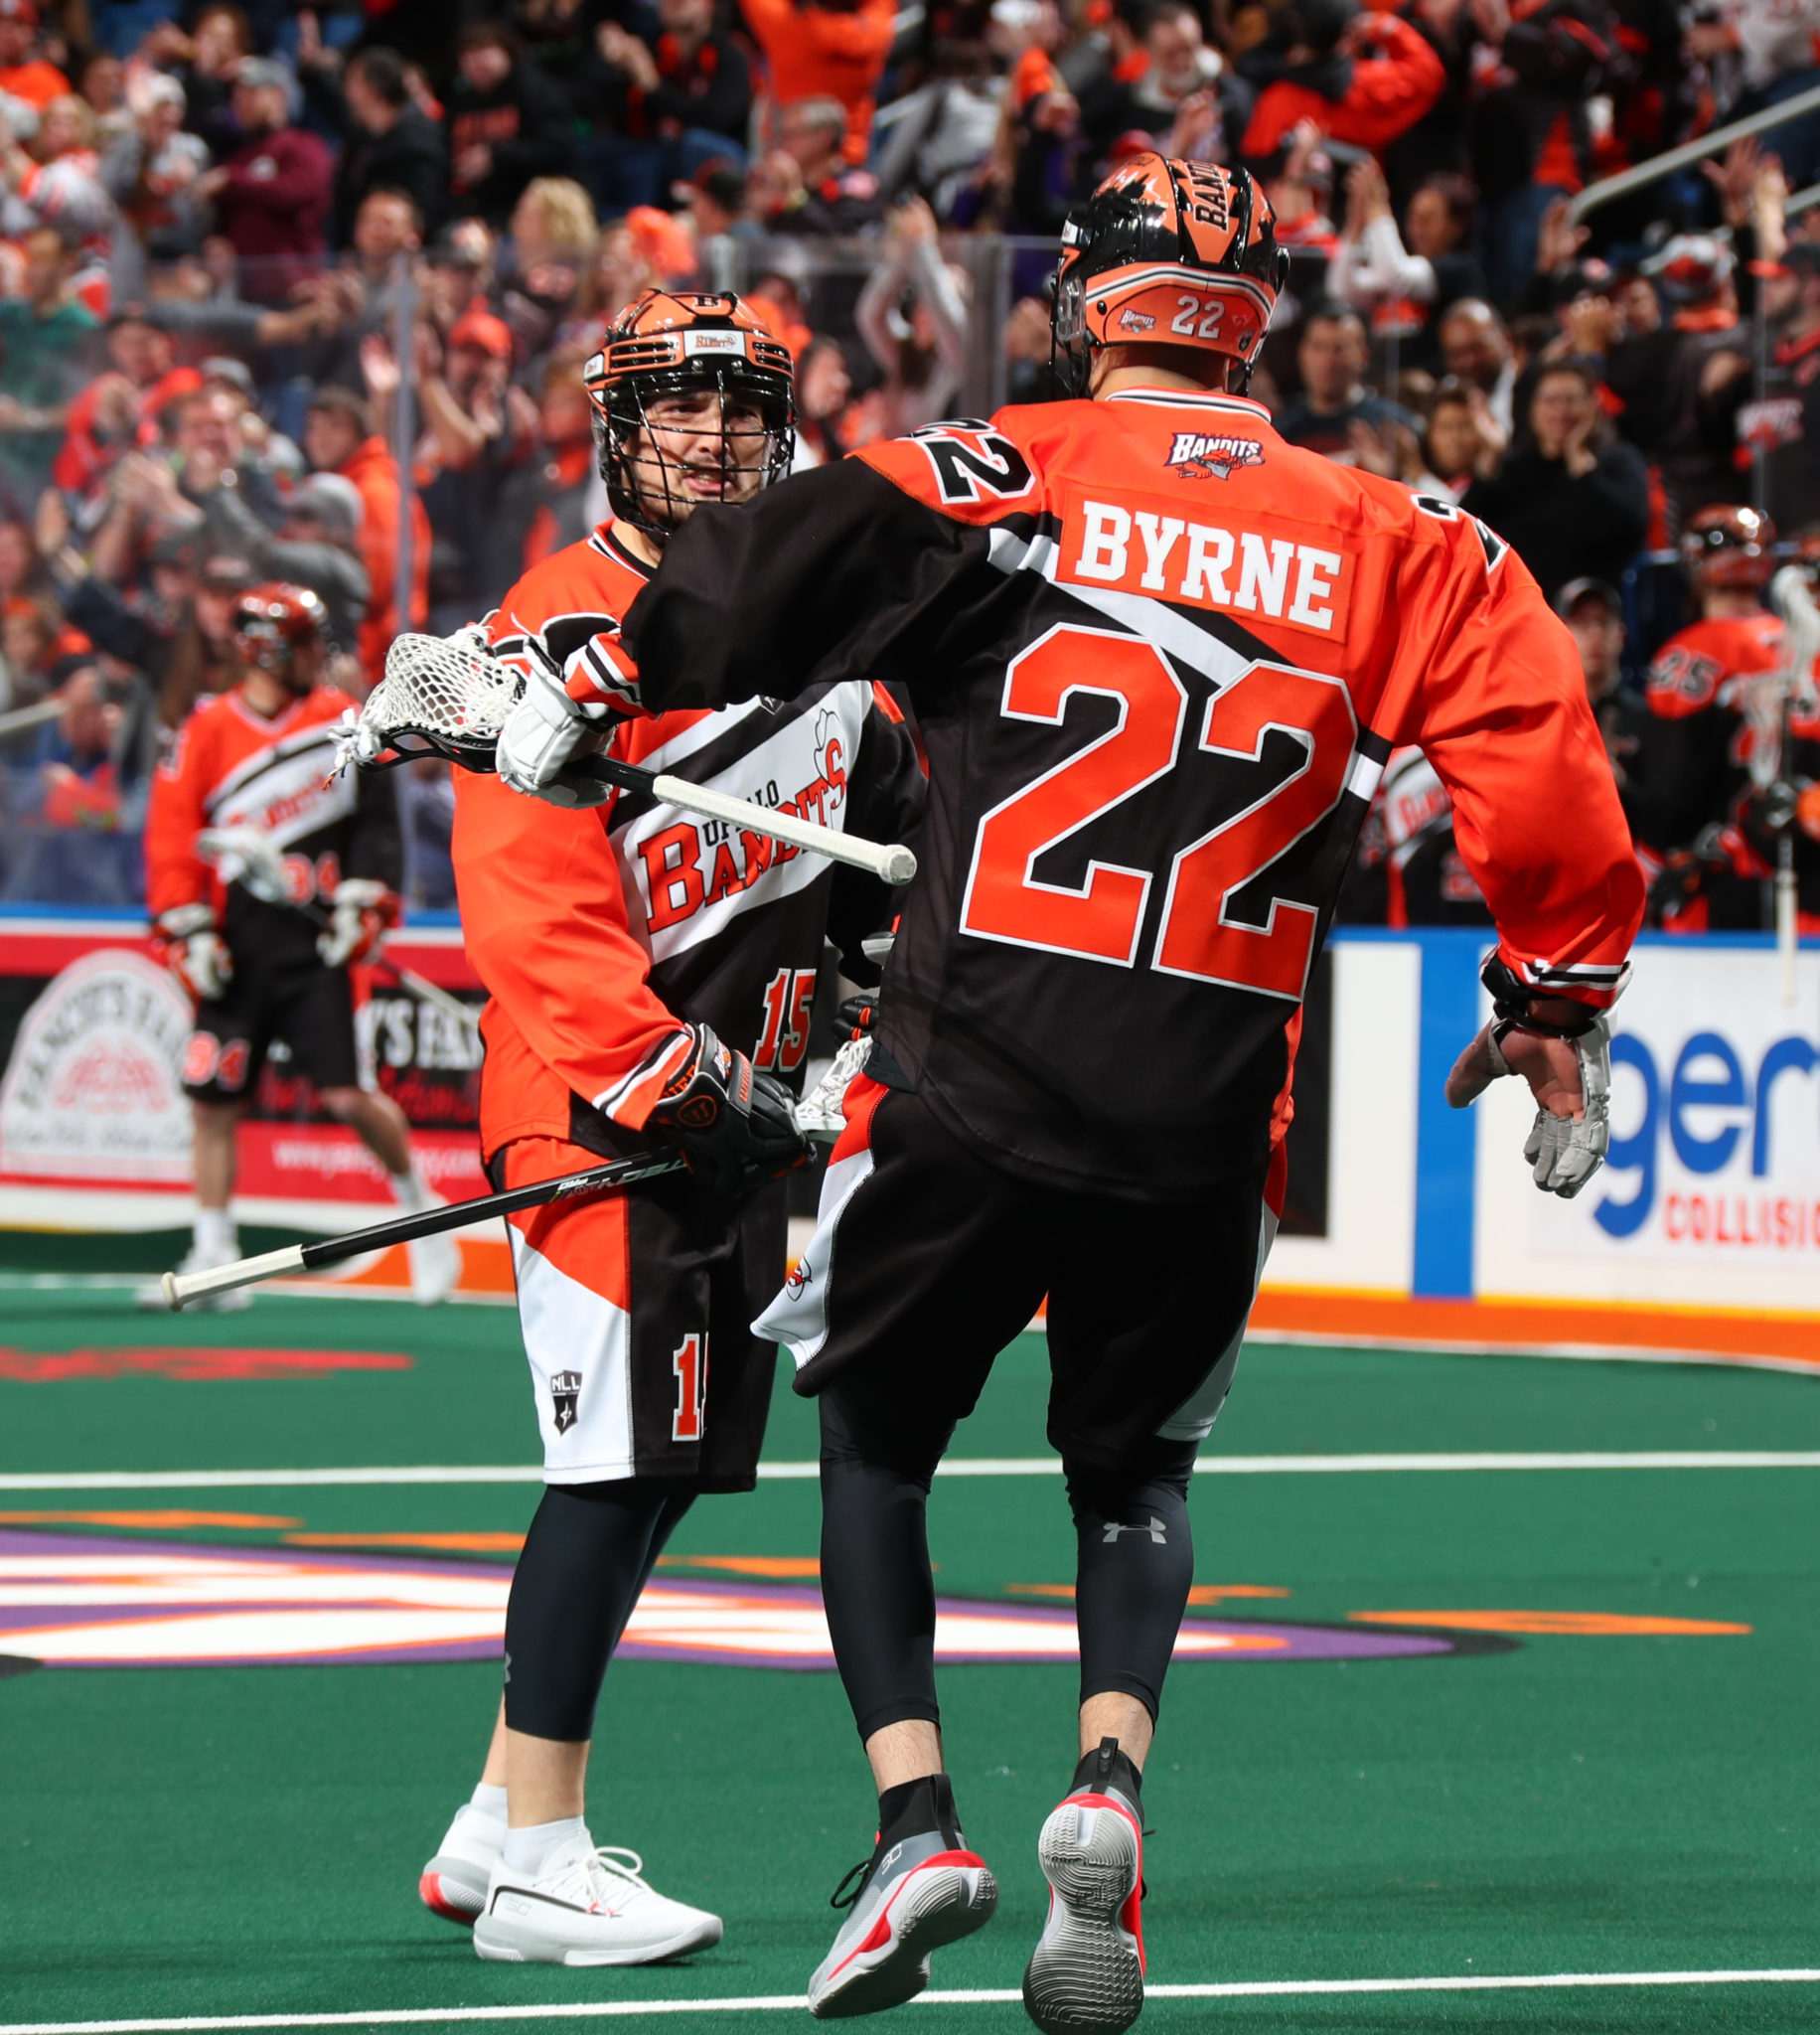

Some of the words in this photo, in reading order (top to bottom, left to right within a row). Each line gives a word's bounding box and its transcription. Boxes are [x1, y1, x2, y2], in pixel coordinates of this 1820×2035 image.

[1170, 295, 1225, 339] 22
[1167, 433, 1262, 465] BANDITS
[1075, 500, 1342, 631] BYRNE
[960, 621, 1359, 1004] 22
[752, 968, 818, 1073] 15
[551, 1374, 580, 1392] NLL
[672, 1332, 709, 1441] 1
